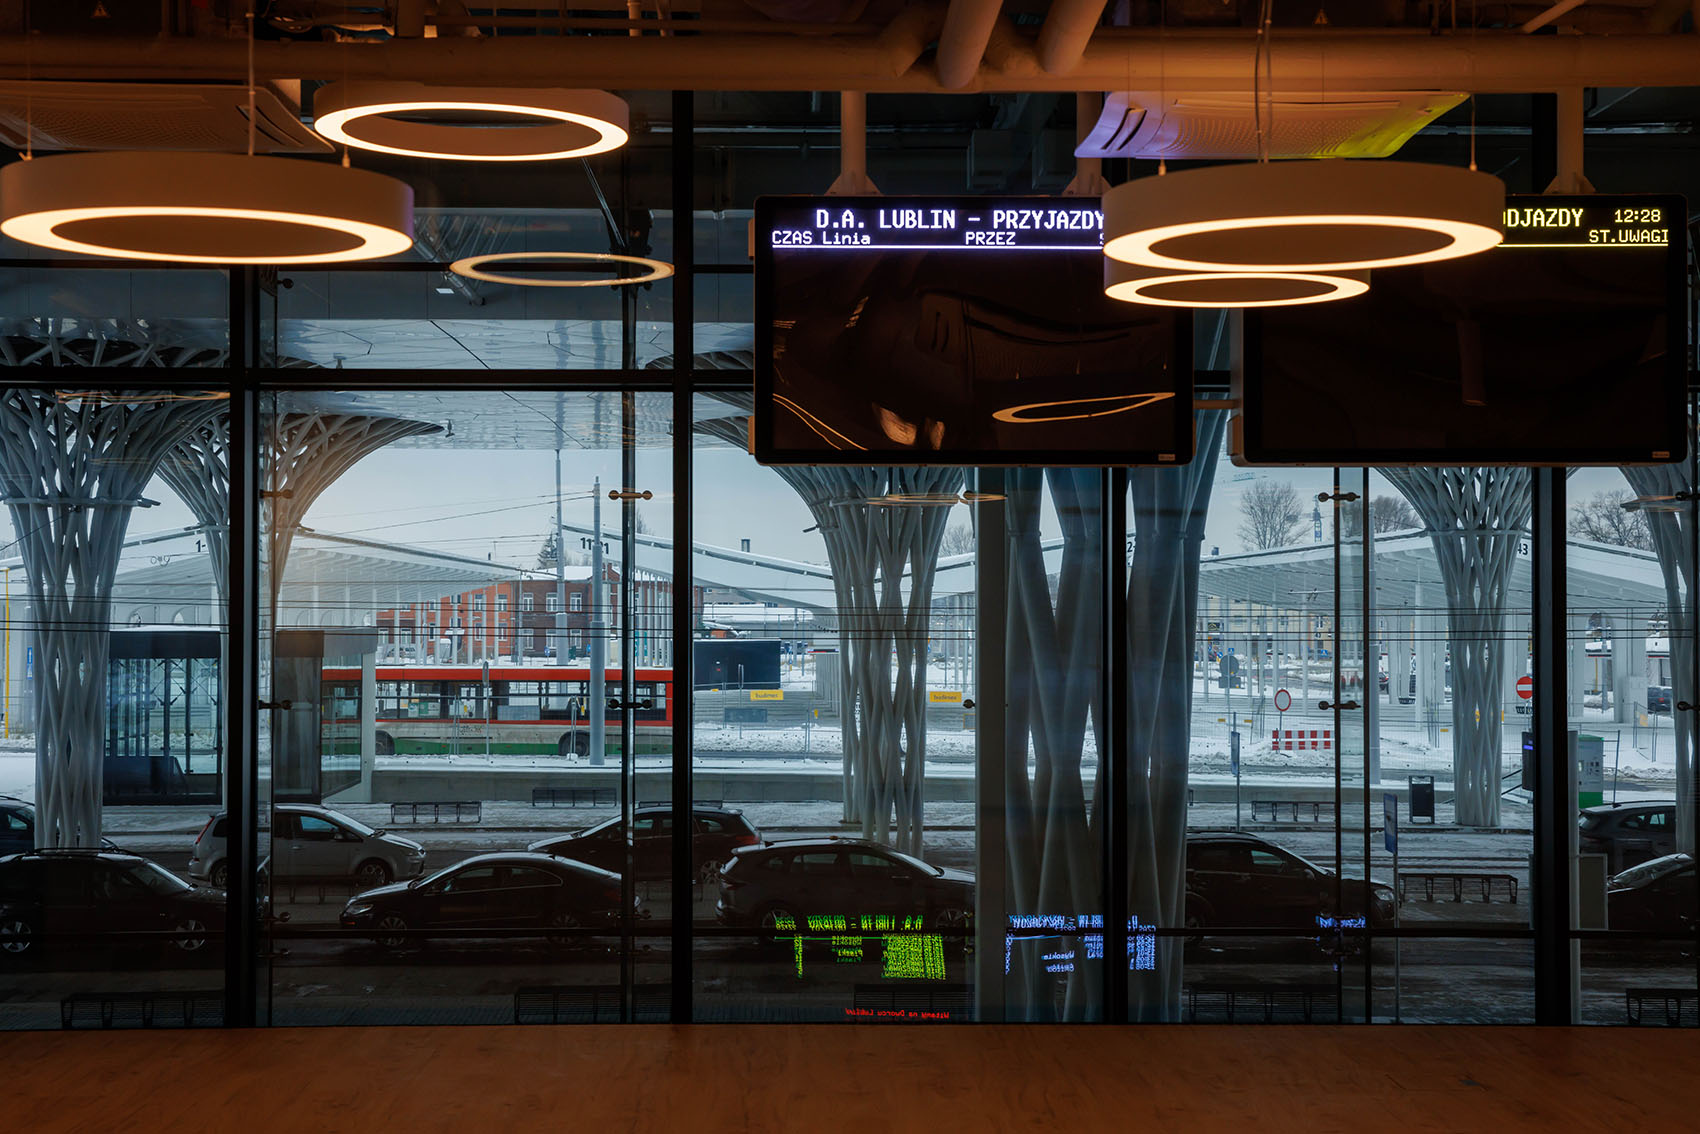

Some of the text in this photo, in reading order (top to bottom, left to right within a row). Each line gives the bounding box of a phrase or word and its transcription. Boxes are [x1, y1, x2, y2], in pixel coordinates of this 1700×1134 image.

[816, 209, 865, 229] D.A.
[879, 209, 956, 229] LUBLIN
[993, 209, 1104, 230] PRZYJAZDY
[1502, 208, 1661, 227] DJAZDY 12:28
[772, 230, 1016, 246] CZAS Linia PRZEZ
[1589, 229, 1669, 243] ST.UWAGI
